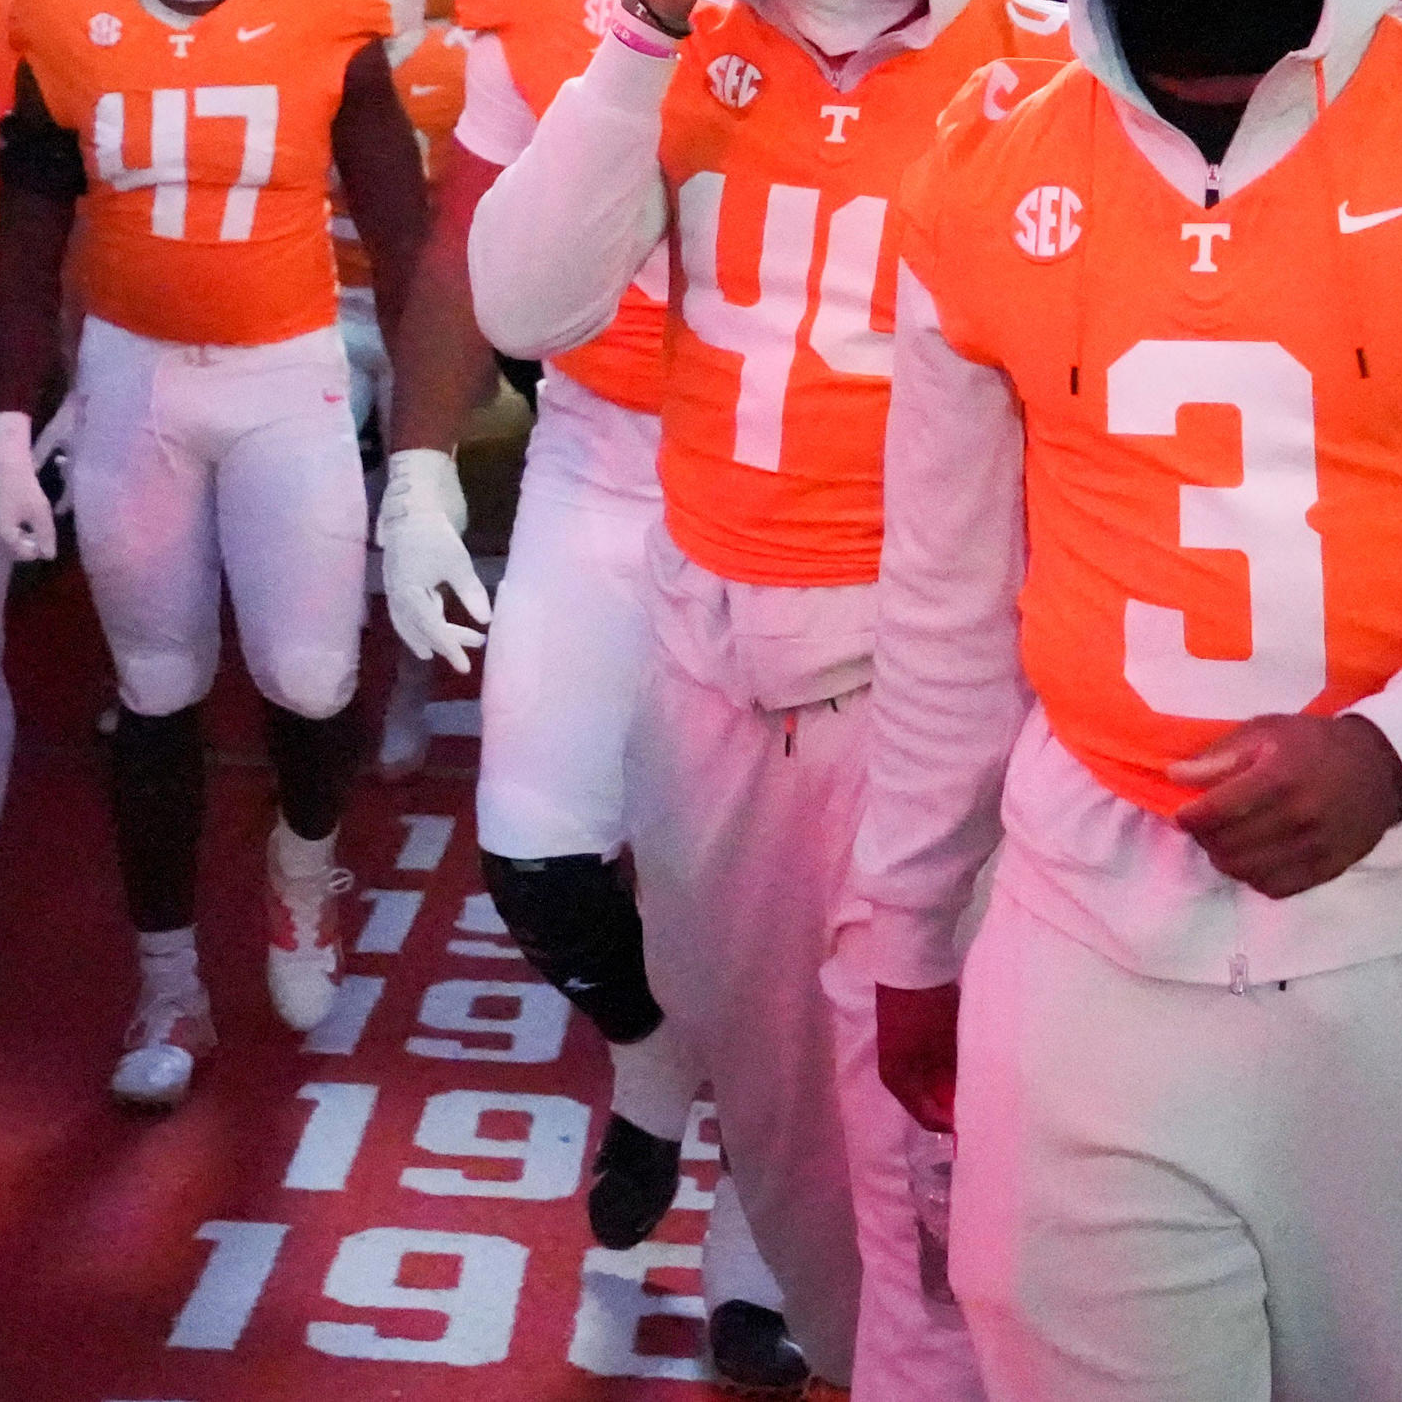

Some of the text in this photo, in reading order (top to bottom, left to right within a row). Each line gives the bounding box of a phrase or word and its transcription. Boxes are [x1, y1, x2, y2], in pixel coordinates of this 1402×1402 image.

[168, 34, 196, 59] T
[706, 54, 763, 110] SEC
[819, 104, 860, 143] T
[93, 85, 279, 241] 47
[1014, 185, 1085, 257] SEC
[1180, 222, 1232, 273] T
[1106, 339, 1327, 721] 3
